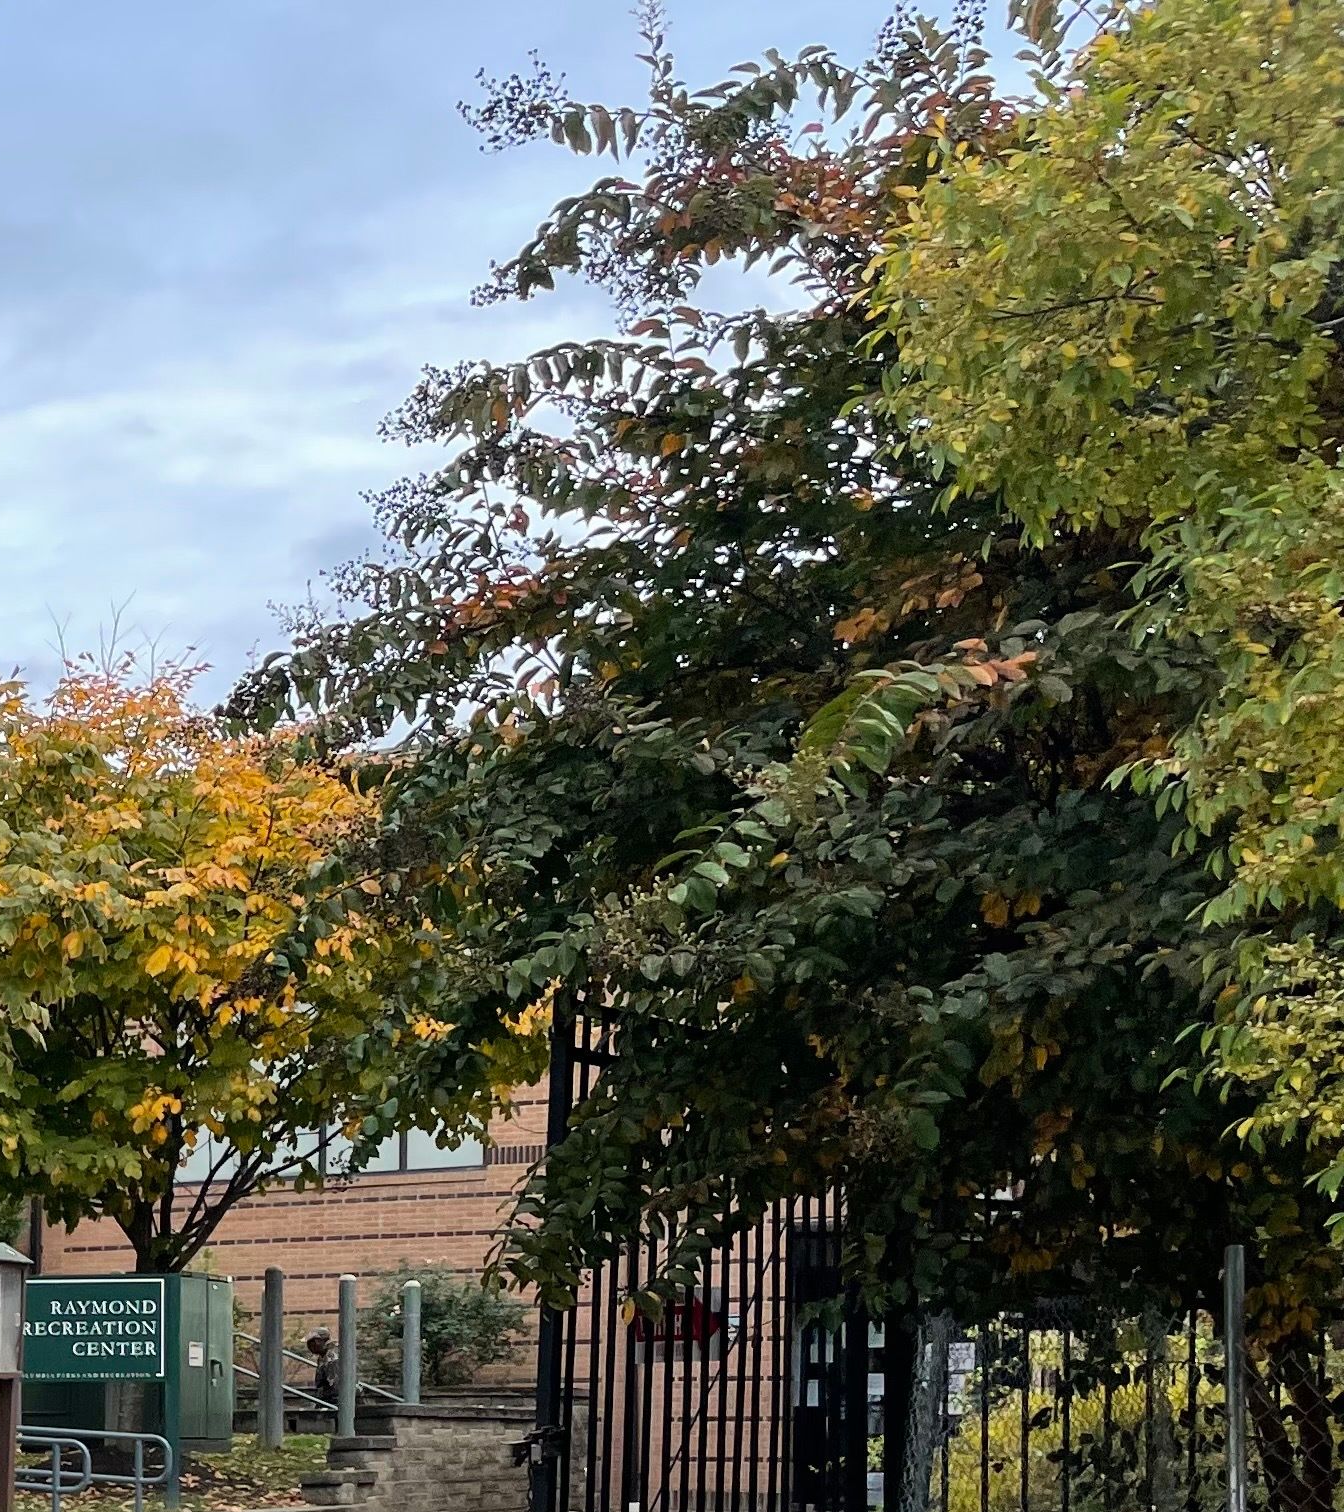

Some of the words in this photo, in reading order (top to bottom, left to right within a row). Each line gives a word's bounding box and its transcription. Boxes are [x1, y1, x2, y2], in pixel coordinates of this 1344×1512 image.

[50, 1300, 156, 1314] RAYMOND
[23, 1321, 156, 1335] RECREATION
[73, 1342, 156, 1356] CENTER
